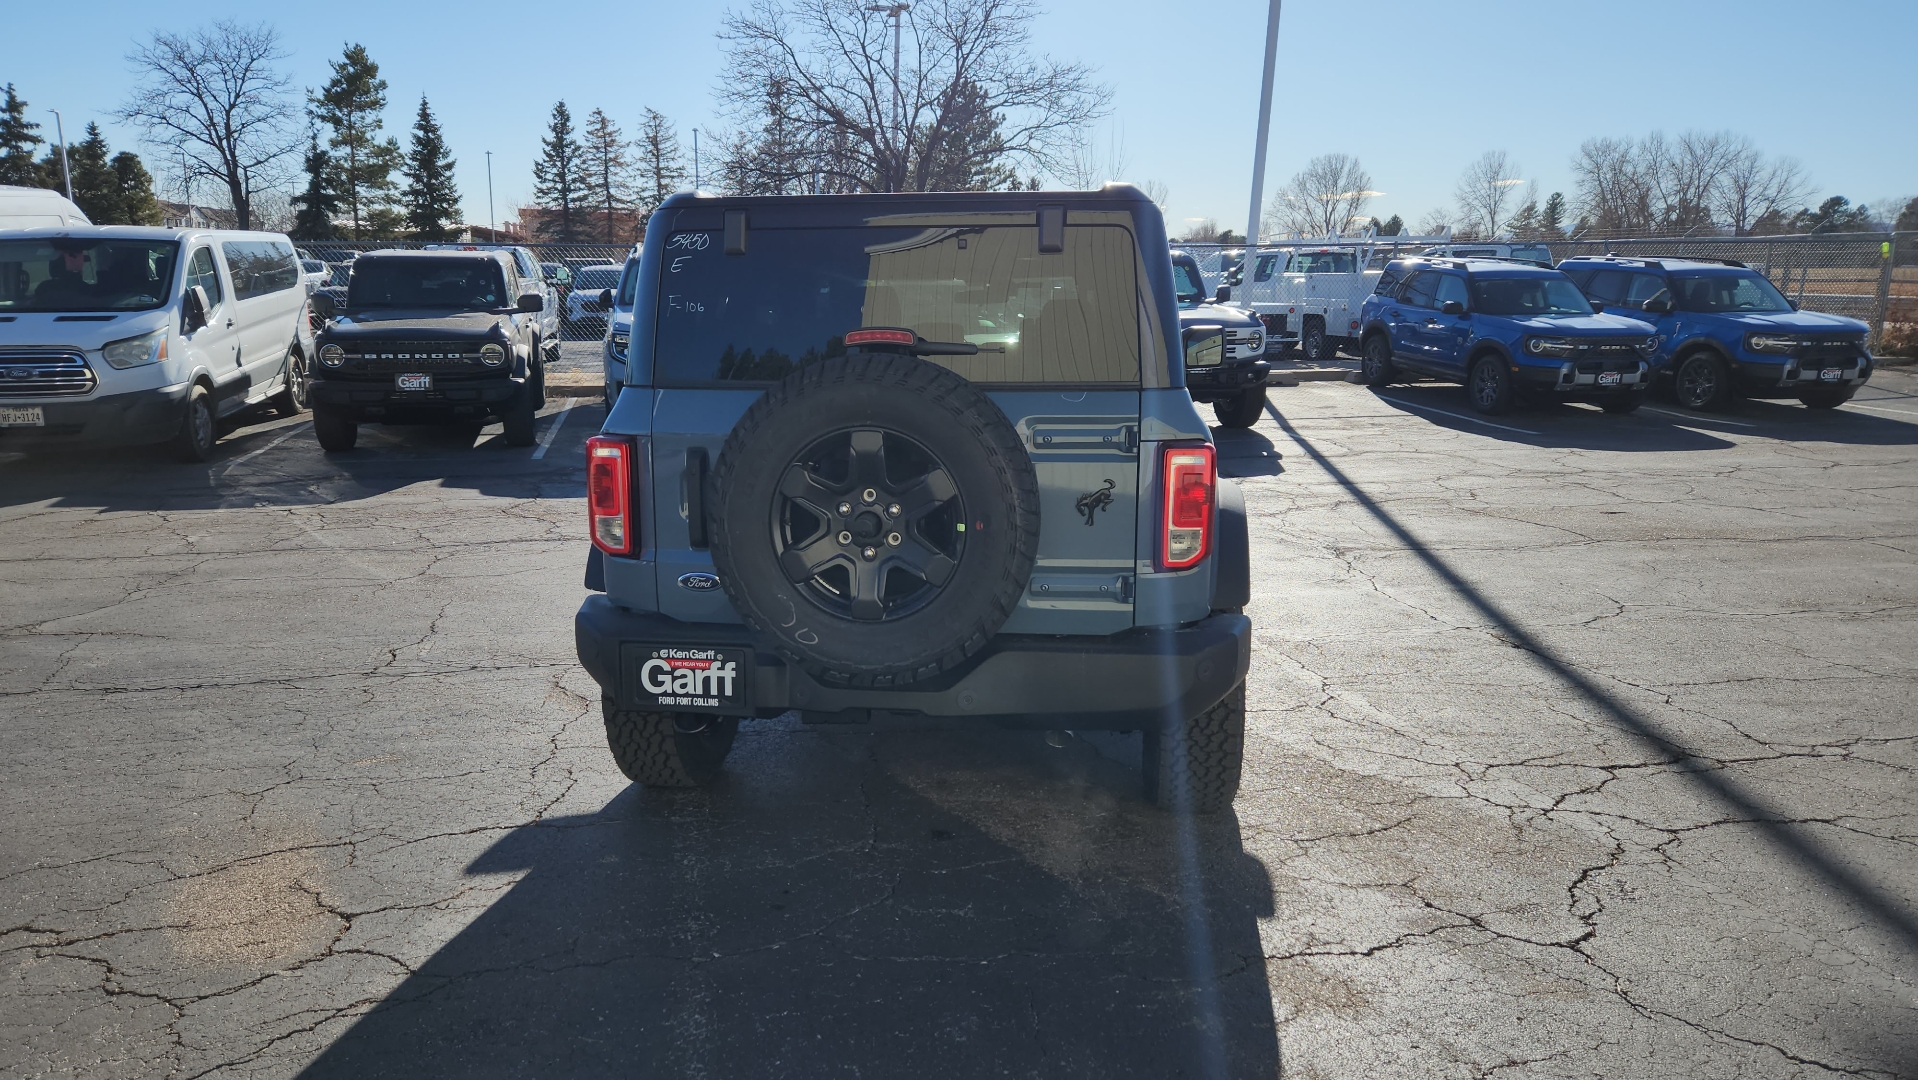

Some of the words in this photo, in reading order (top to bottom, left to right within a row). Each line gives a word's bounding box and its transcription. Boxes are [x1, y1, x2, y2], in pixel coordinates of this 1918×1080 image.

[666, 233, 710, 250] 5450
[670, 255, 693, 273] E
[1598, 374, 1621, 383] Garff
[1820, 369, 1842, 379] Garff
[398, 376, 430, 388] Garff
[687, 576, 712, 588] Ford
[669, 648, 690, 659] Ken
[690, 649, 715, 660] Garff
[640, 658, 736, 697] Garff
[658, 696, 675, 705] FORD
[676, 696, 692, 706] FORT
[693, 697, 719, 707] COLLINS
